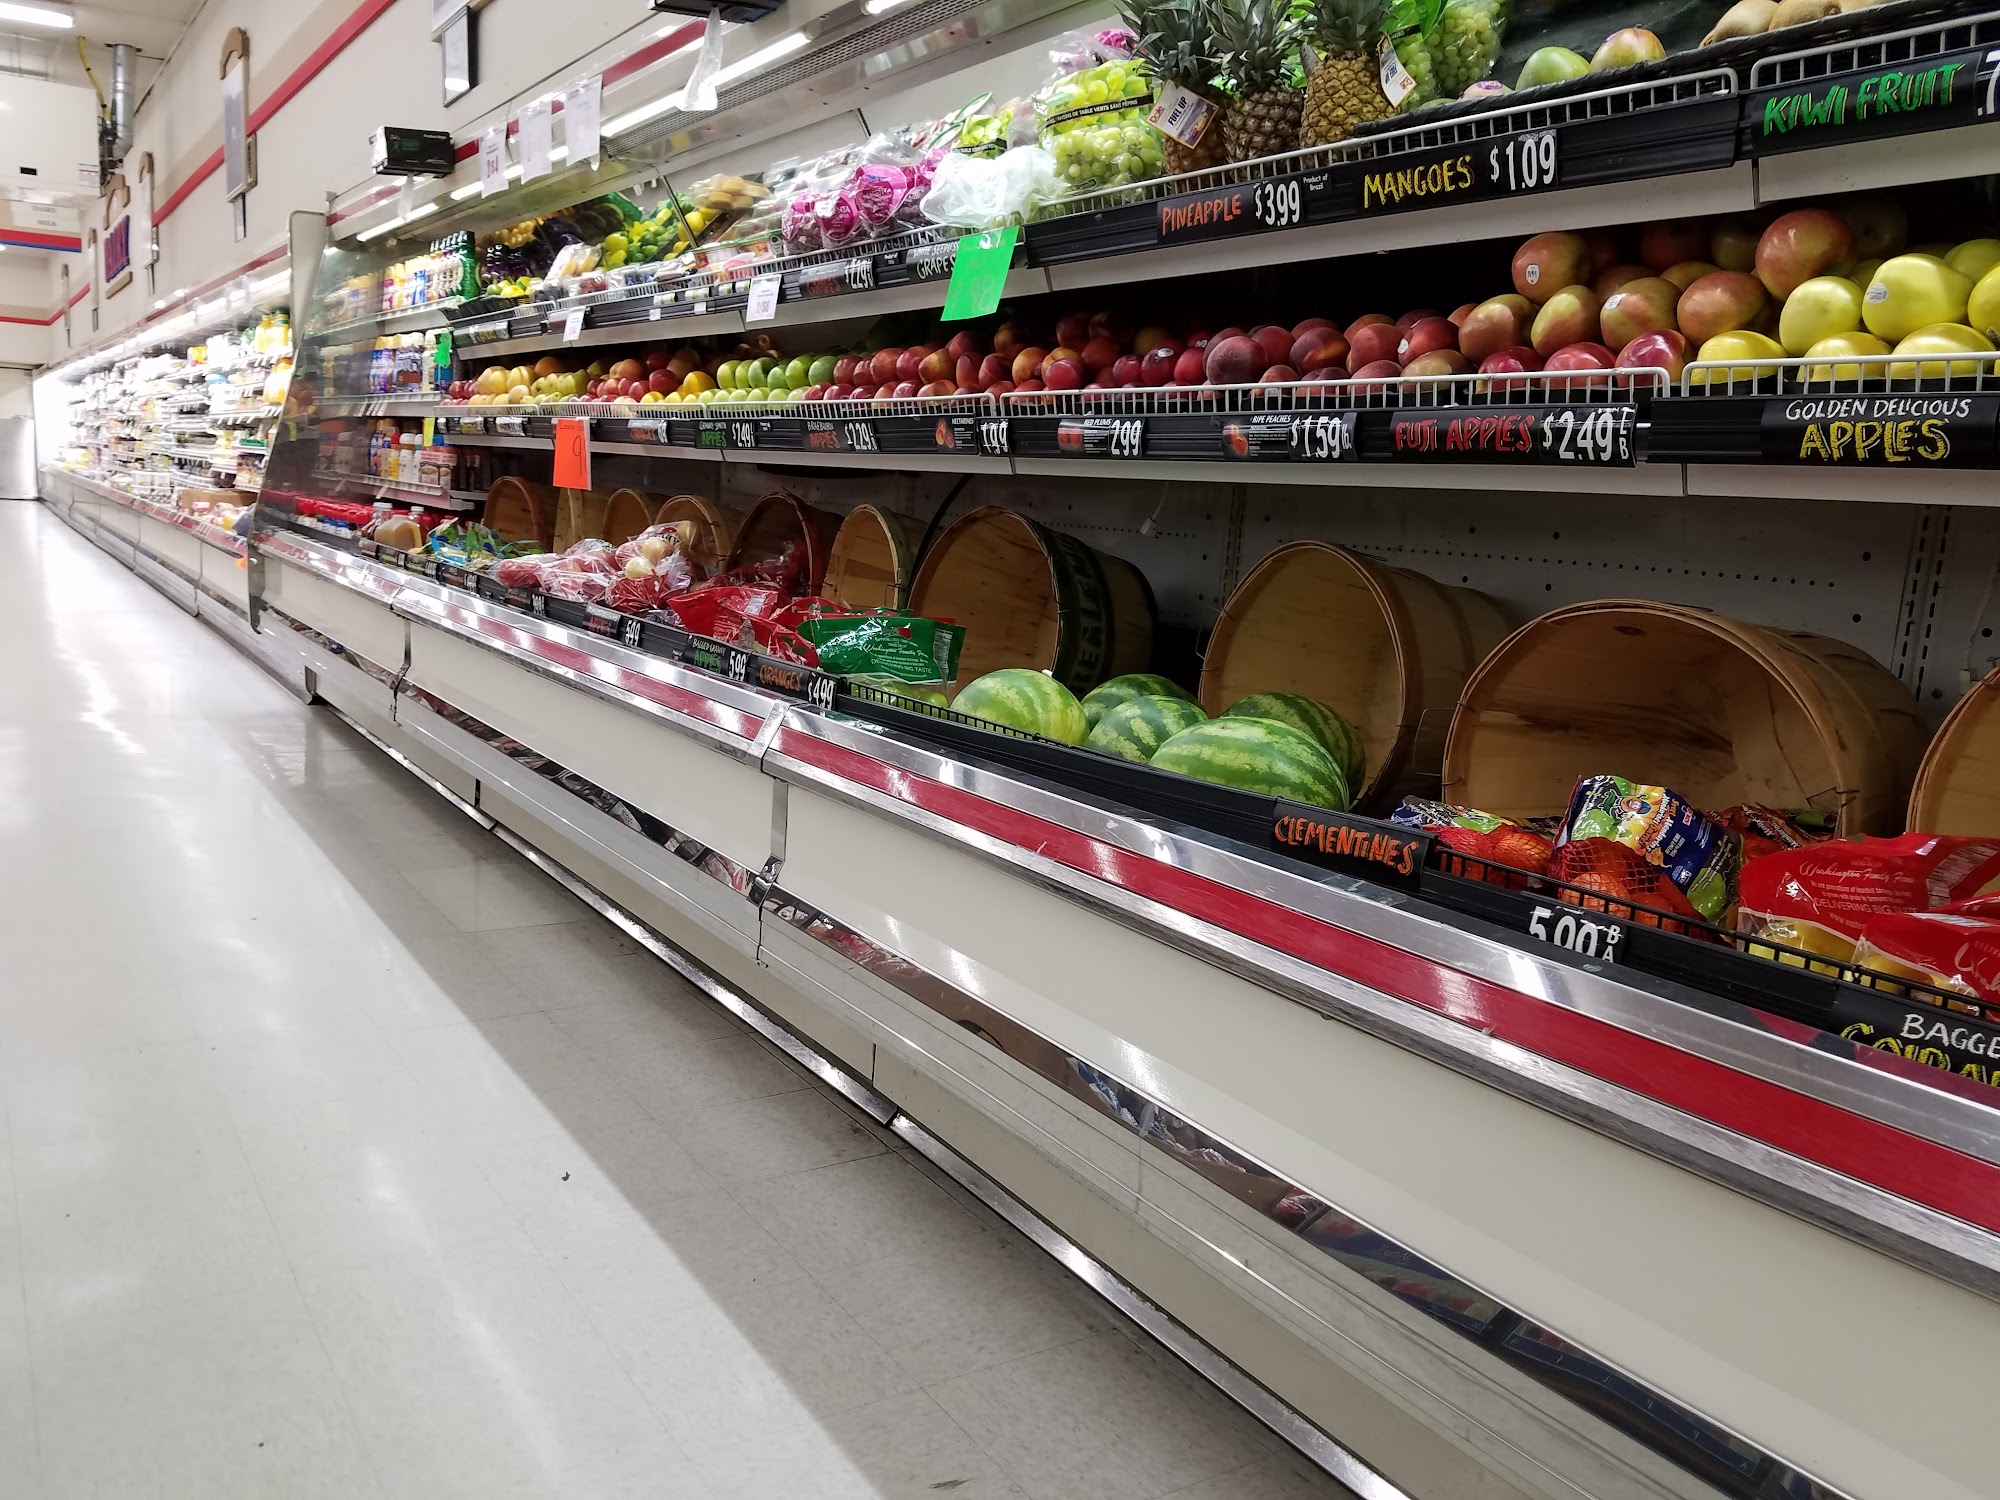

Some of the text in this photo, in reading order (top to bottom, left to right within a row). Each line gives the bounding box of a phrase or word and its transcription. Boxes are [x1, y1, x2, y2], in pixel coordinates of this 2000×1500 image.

[1763, 62, 1966, 136] KIWI FRUIT
[1149, 105, 1164, 124] Dole
[1168, 96, 1188, 126] FUEL UP
[1303, 173, 1328, 186] Product of
[1364, 134, 1556, 209] MANGOES $1.09
[1309, 181, 1325, 191] Brazil
[1162, 180, 1300, 236] PINEAPPLE $3.99
[1252, 414, 1292, 424] RIPE PEACHES
[1785, 397, 1973, 420] GOLDEN DELICIOUS
[809, 431, 841, 449] APPLES
[1446, 414, 1536, 452] APPLES
[1543, 410, 1613, 461] $2.49
[1799, 418, 1951, 462] APPLES
[760, 664, 803, 691] ORANGES
[914, 666, 932, 674] TASTE
[1800, 860, 1862, 884] Washington
[1814, 897, 1872, 914] DELIVERING
[1873, 904, 1891, 915] BIG
